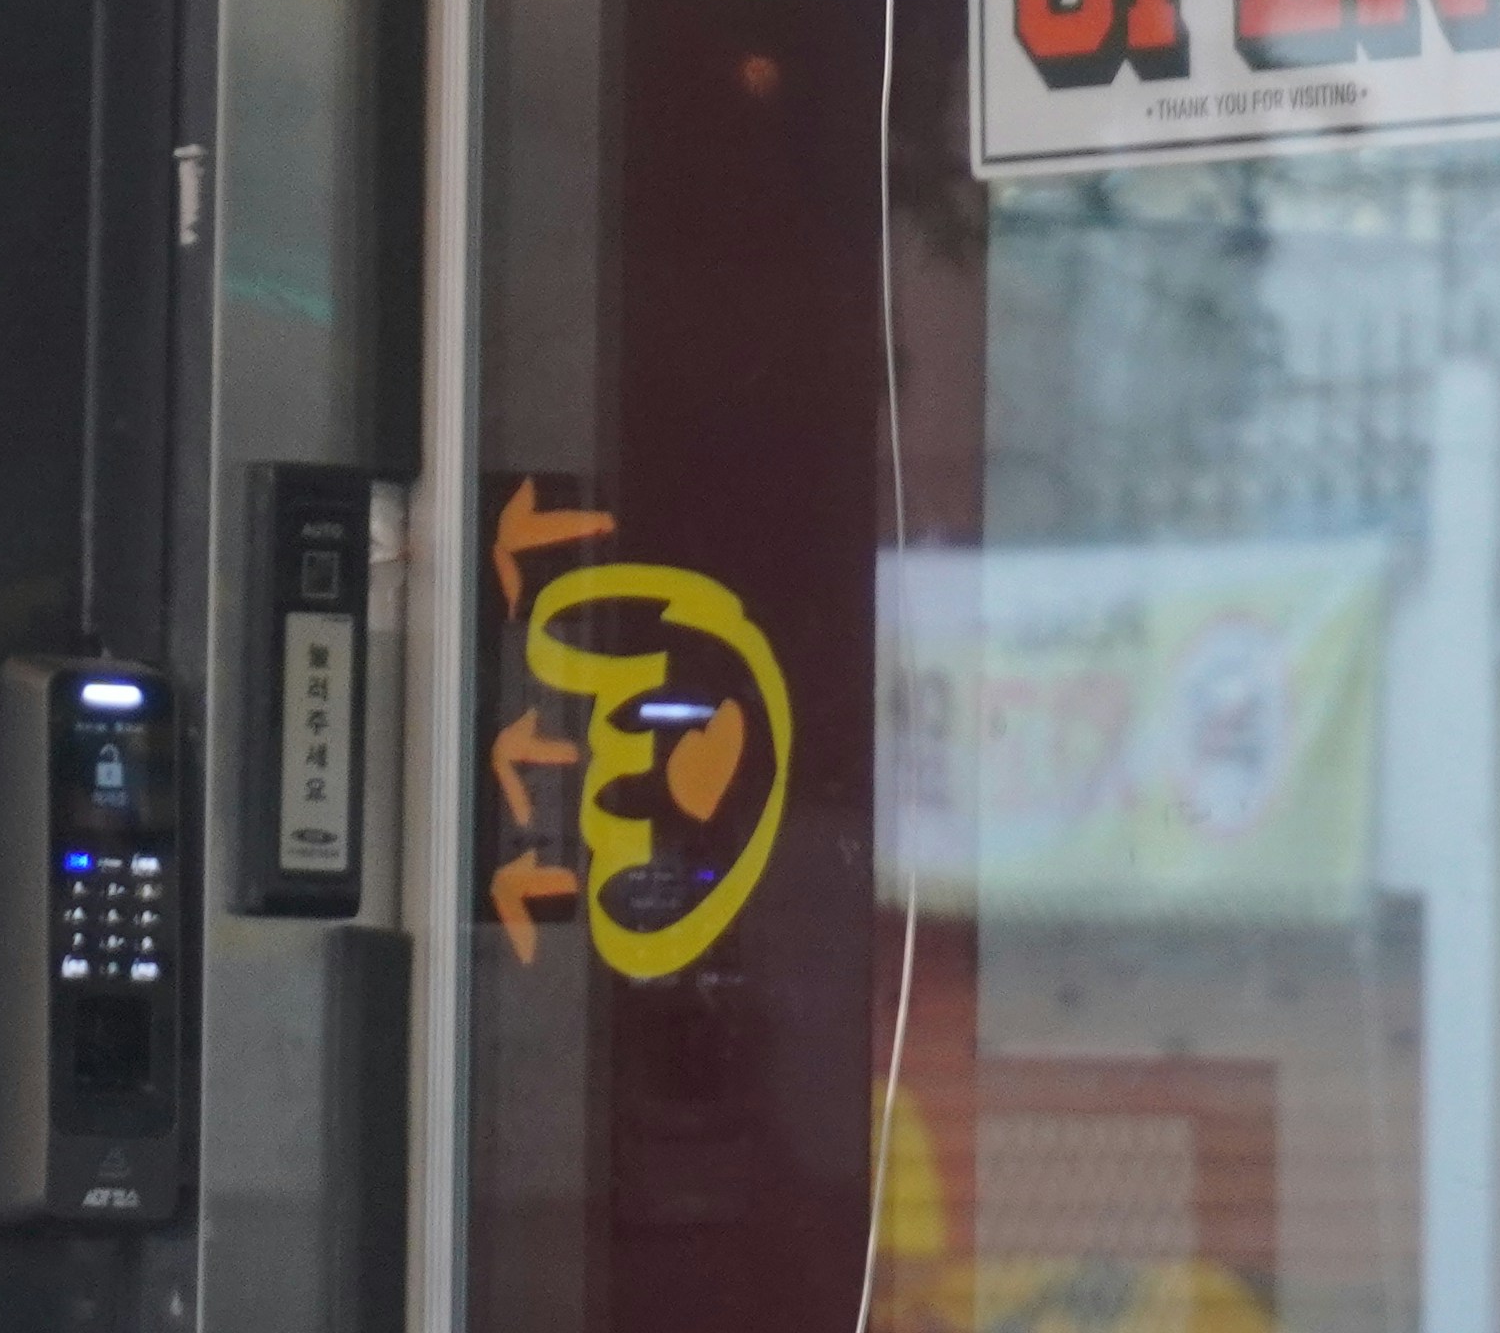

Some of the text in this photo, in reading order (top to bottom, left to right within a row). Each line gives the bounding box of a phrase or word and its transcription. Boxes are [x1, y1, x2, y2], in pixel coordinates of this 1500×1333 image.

[1157, 82, 1358, 121] THANK YOU FOR VISITING
